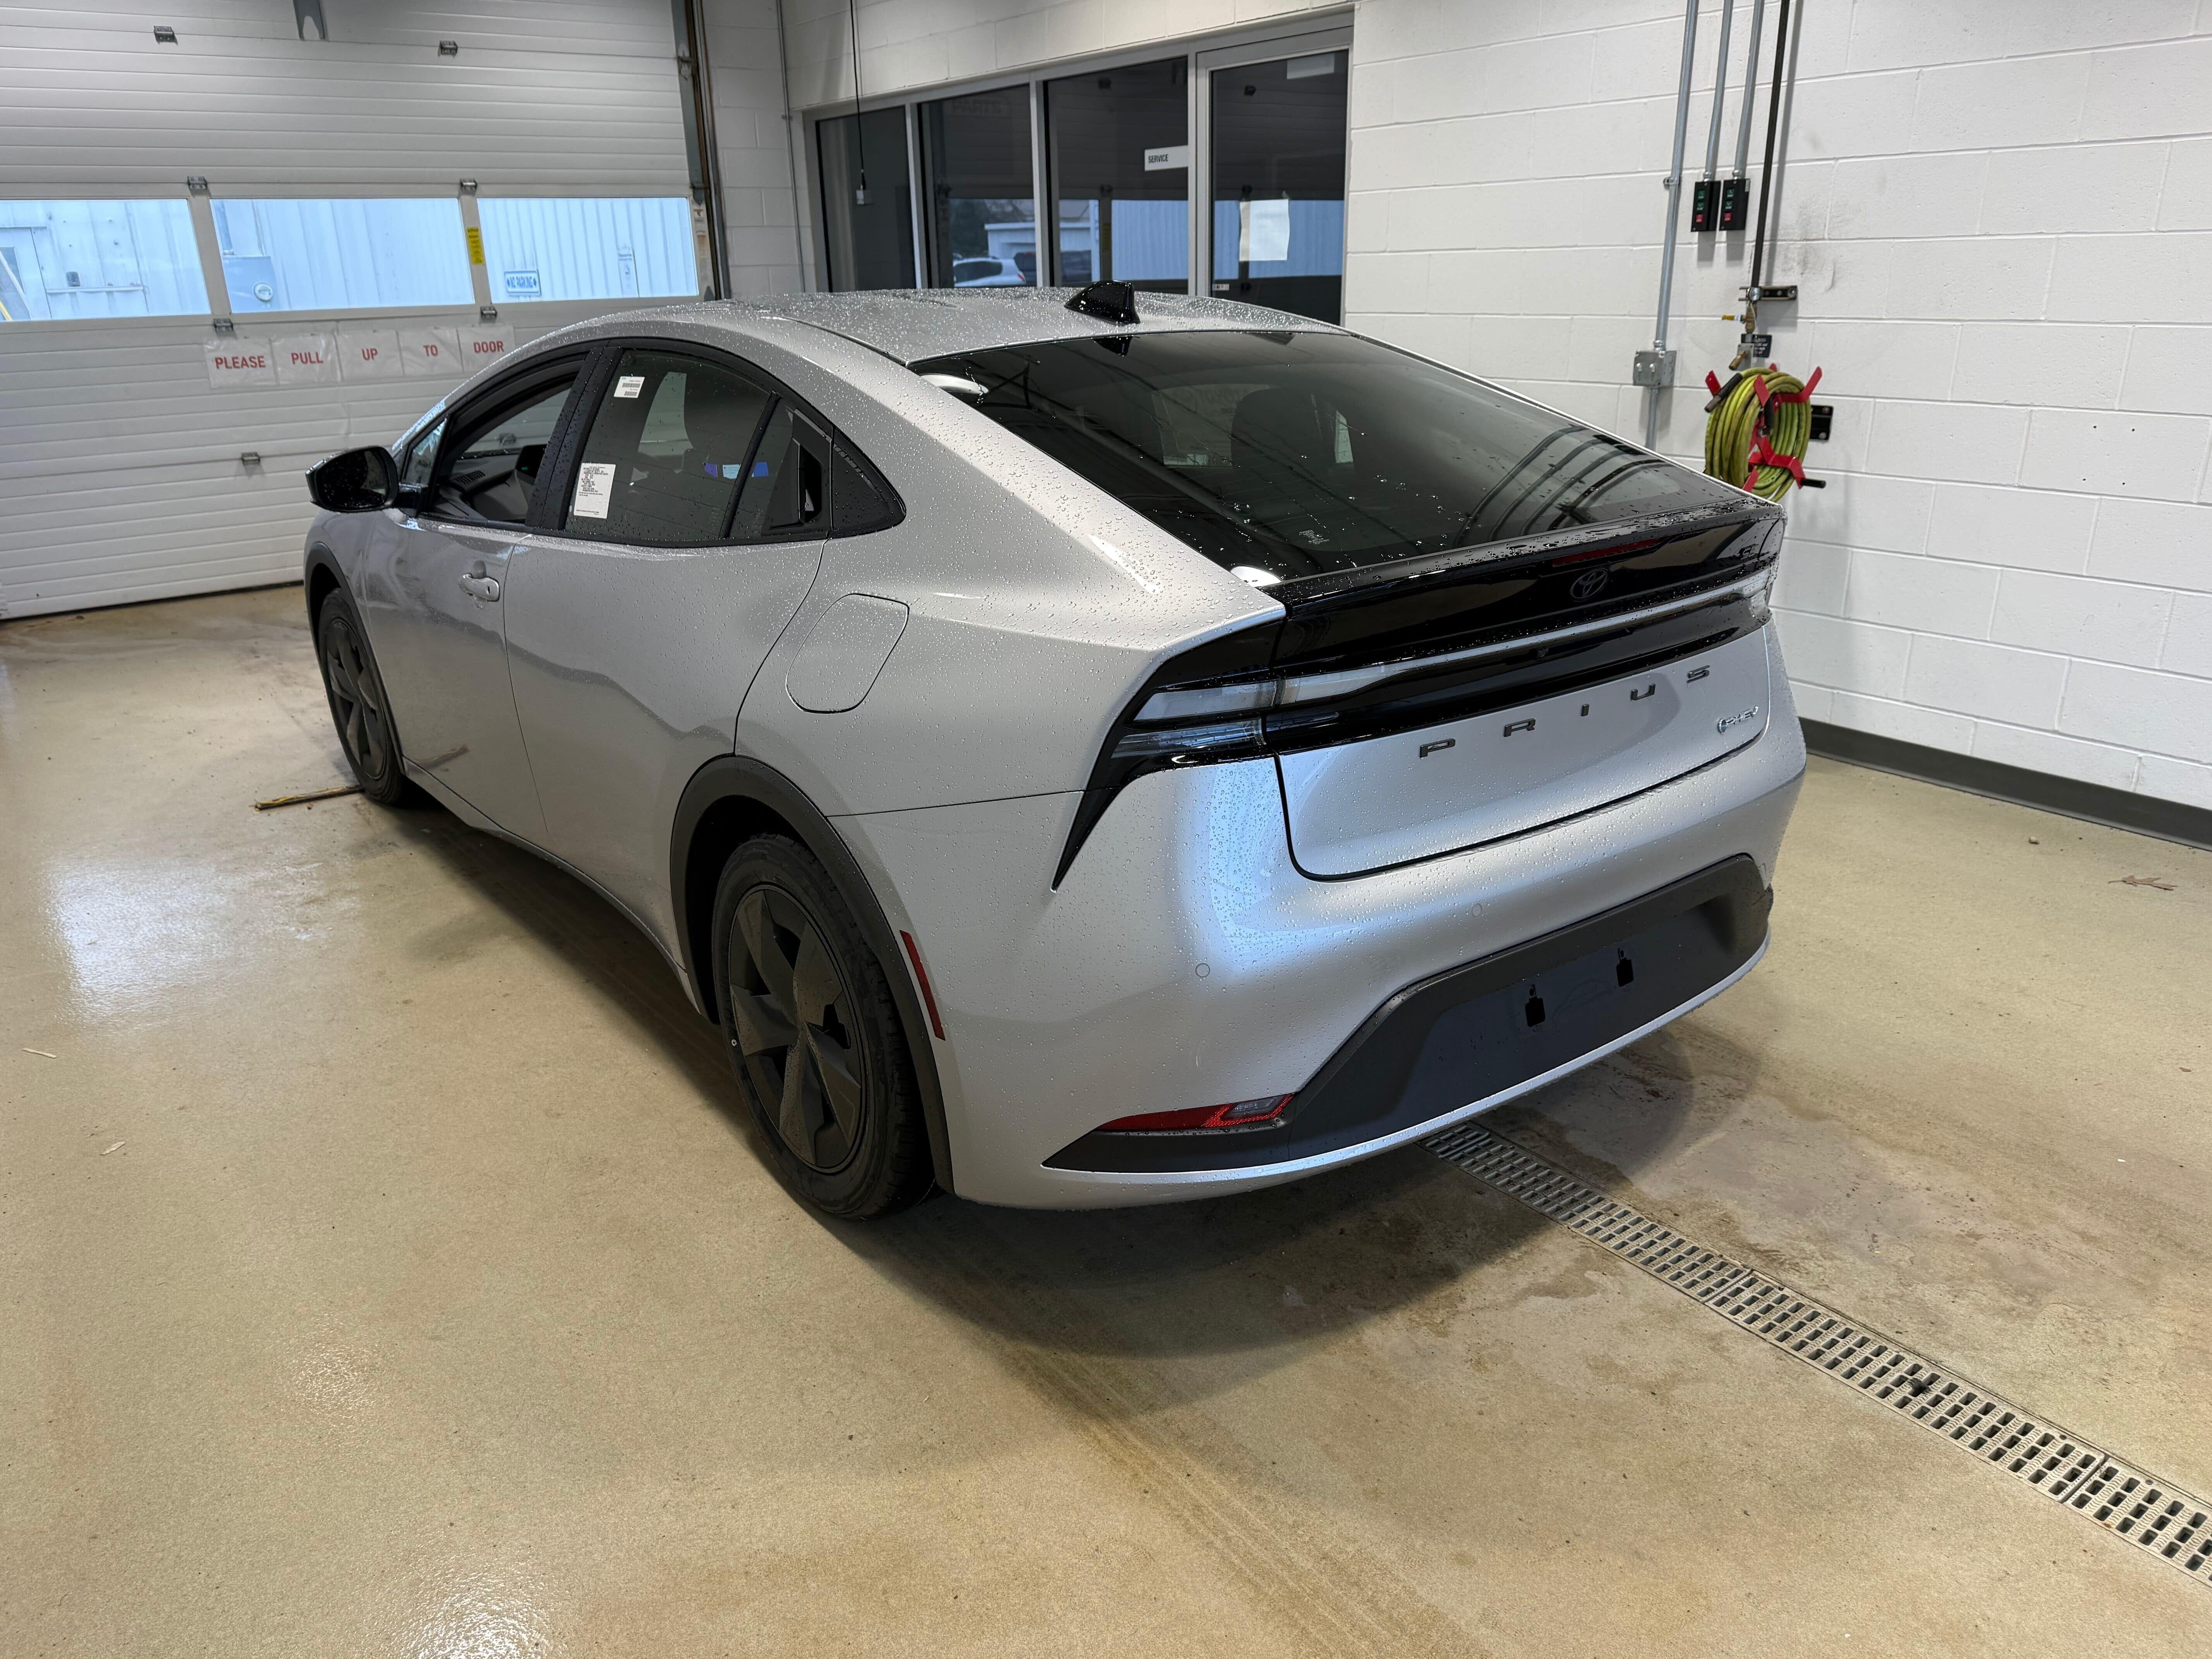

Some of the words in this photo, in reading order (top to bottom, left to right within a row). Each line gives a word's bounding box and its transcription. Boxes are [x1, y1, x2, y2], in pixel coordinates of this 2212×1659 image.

[1148, 154, 1168, 163] SERVICE
[215, 356, 266, 369] PLEASE
[291, 351, 324, 365] PULL
[362, 348, 378, 361] UP
[423, 344, 438, 357] TO
[473, 340, 505, 353] DOOR
[1419, 665, 1710, 759] PRIUS
